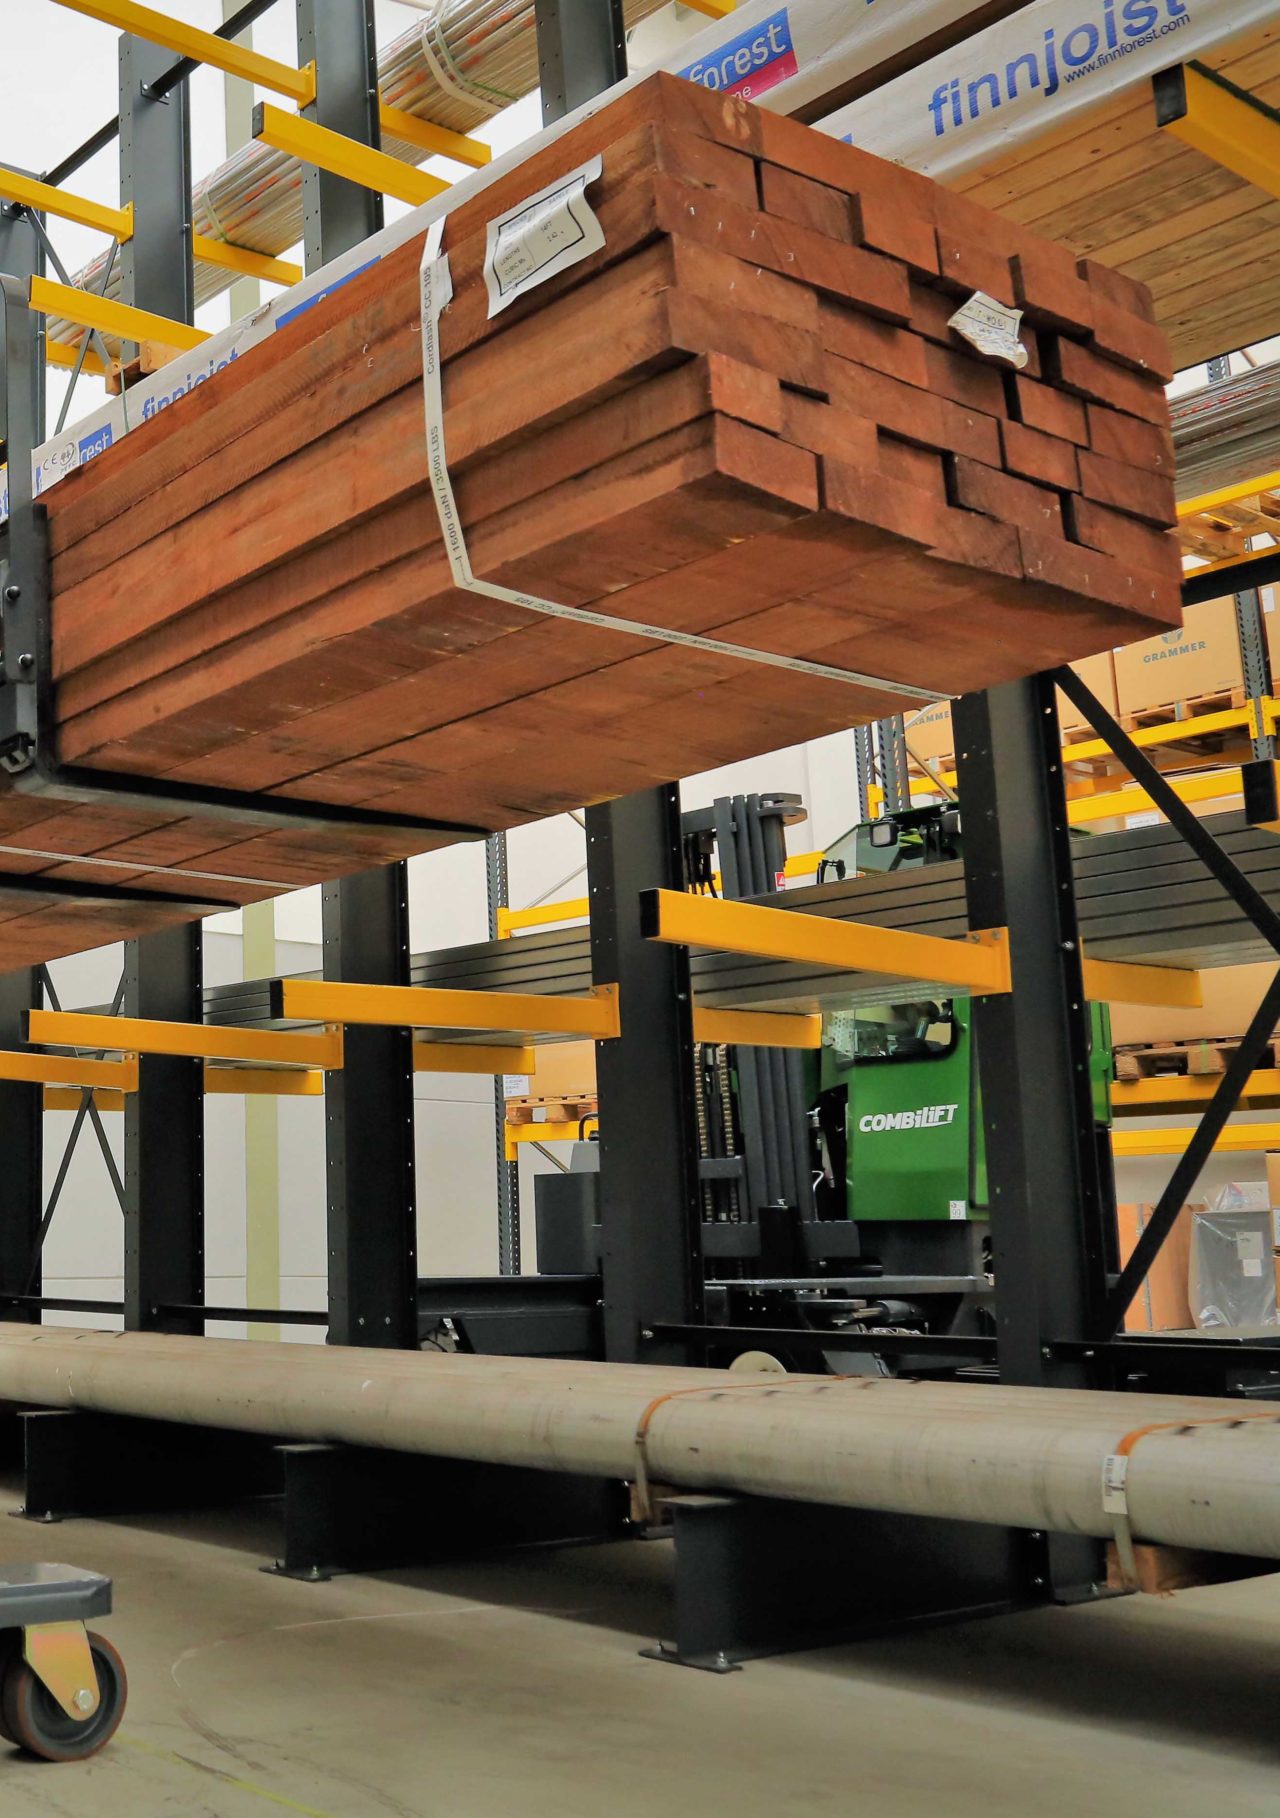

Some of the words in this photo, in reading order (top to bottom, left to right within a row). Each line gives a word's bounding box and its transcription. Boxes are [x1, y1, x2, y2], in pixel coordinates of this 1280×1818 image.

[1063, 13, 1190, 84] www.finnforest.com
[424, 290, 432, 309] CC
[431, 426, 440, 452] LBS
[432, 456, 444, 485] 3500
[1143, 640, 1207, 664] GRAMMER
